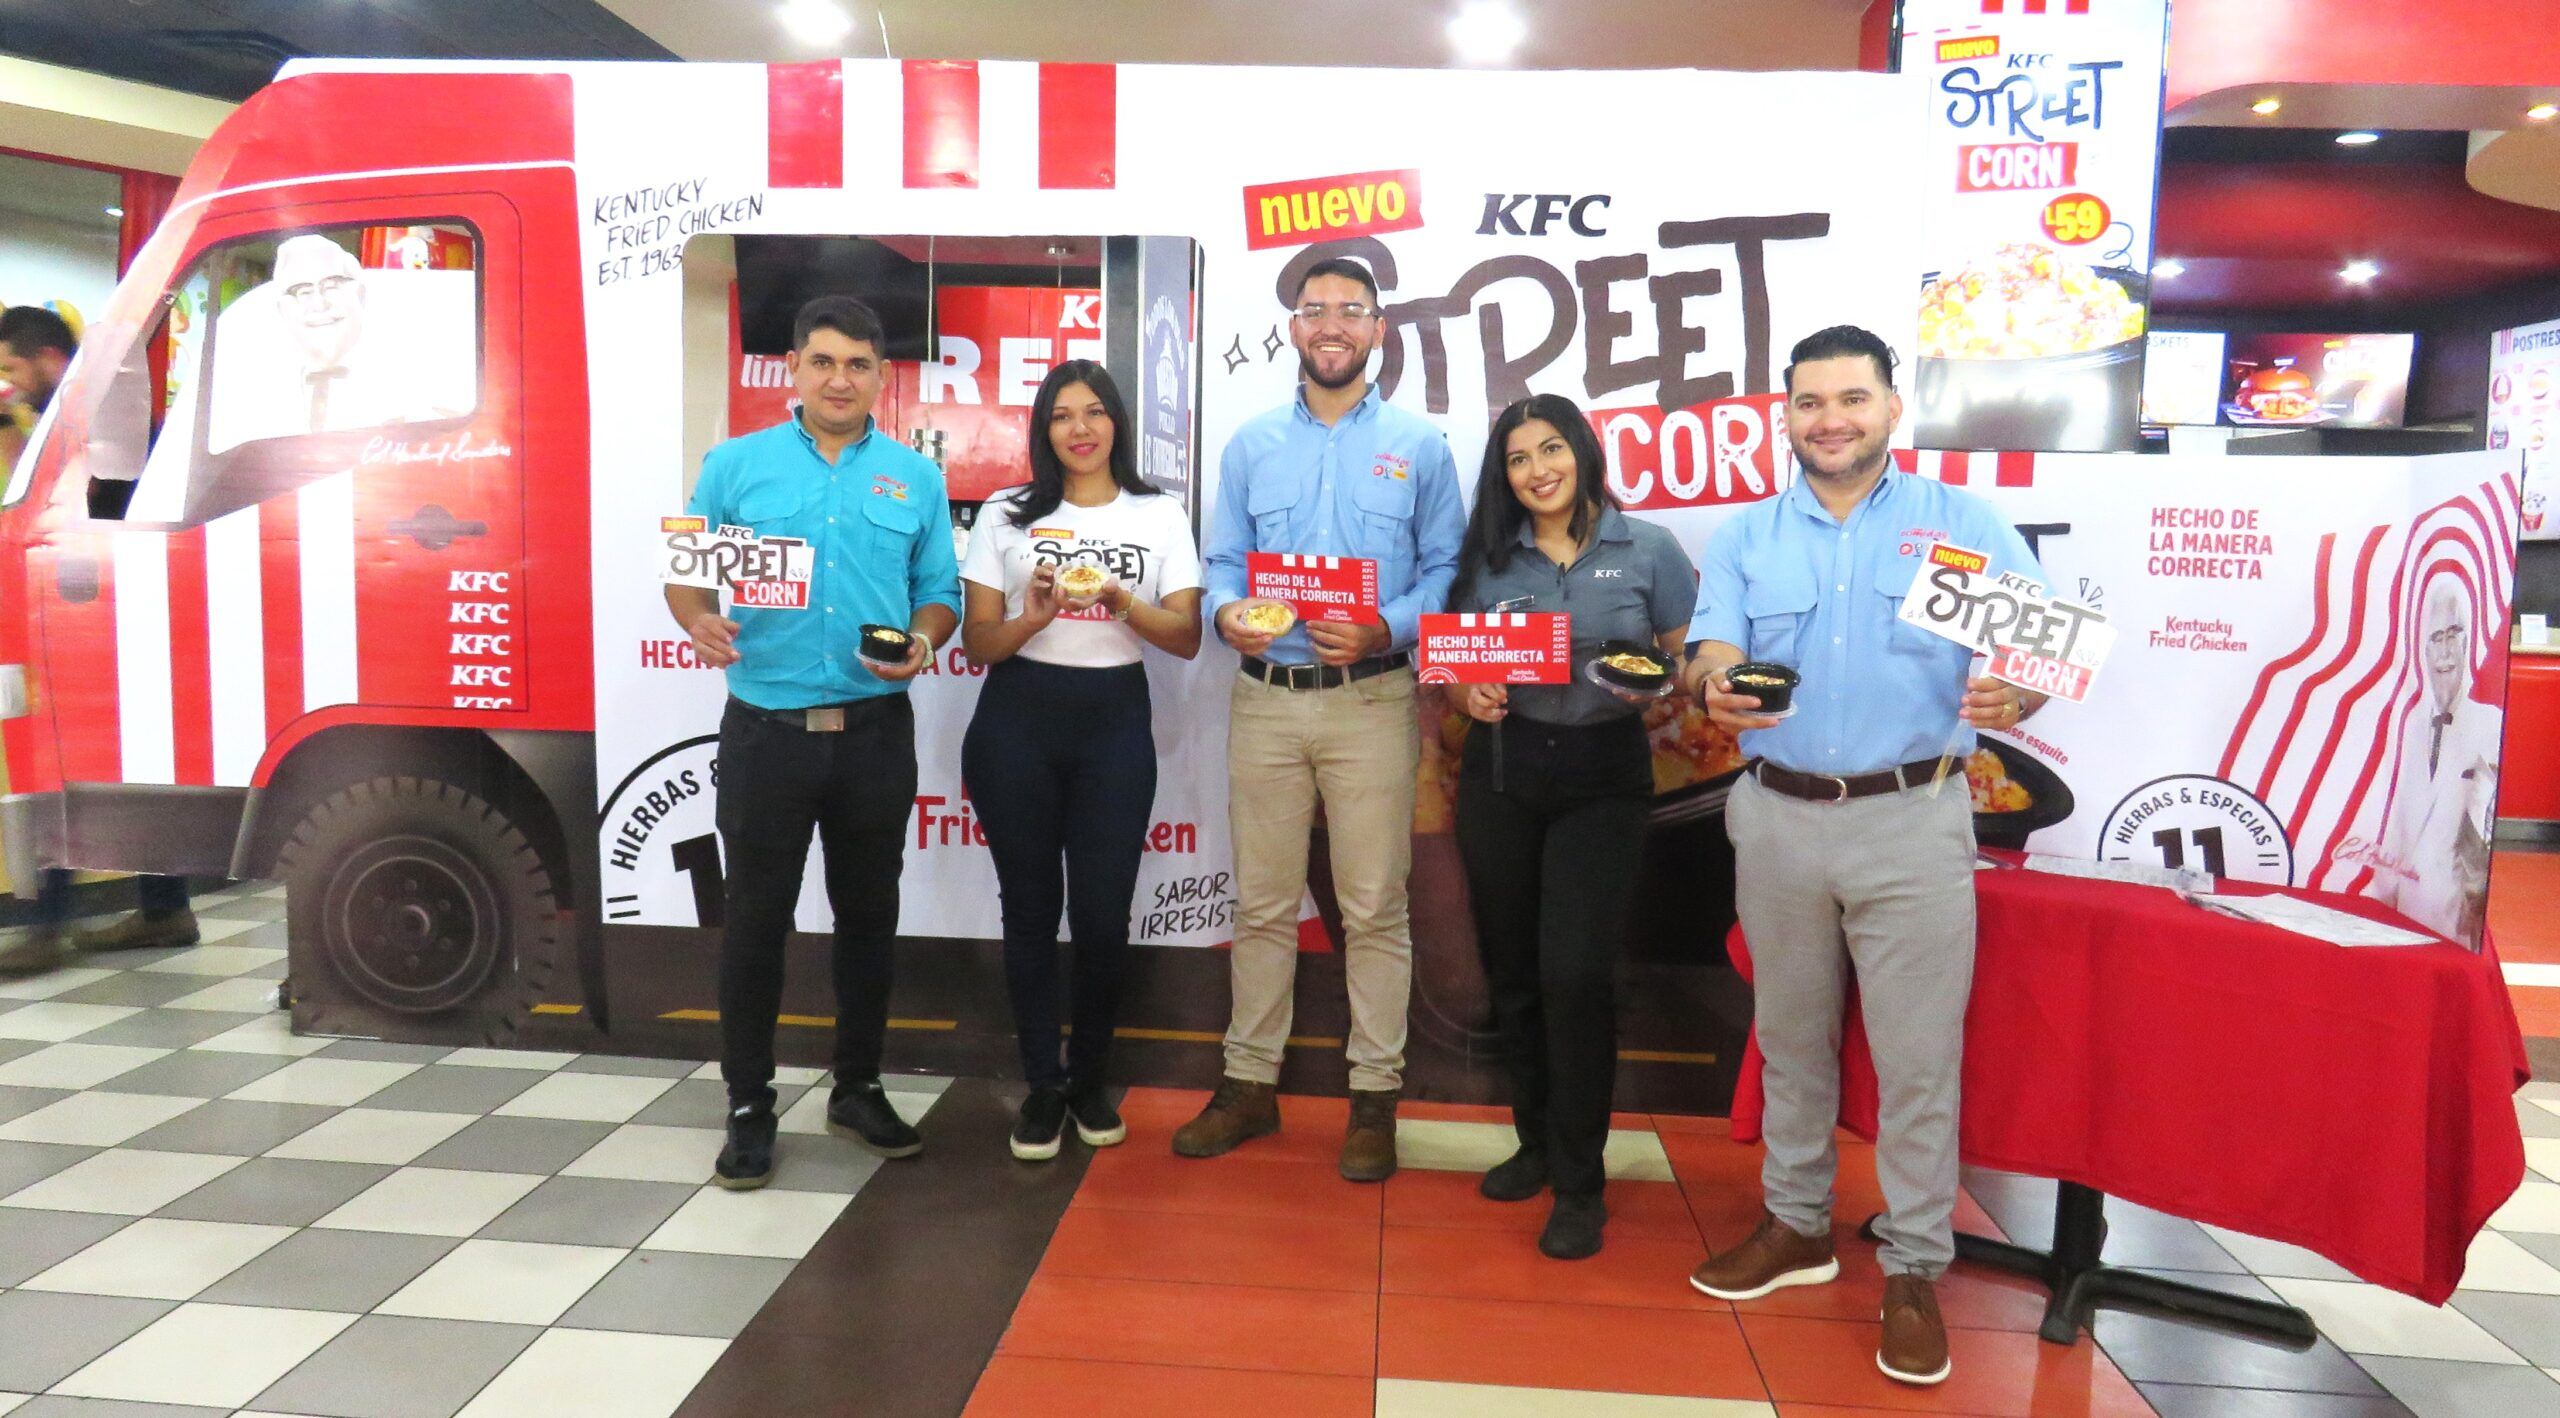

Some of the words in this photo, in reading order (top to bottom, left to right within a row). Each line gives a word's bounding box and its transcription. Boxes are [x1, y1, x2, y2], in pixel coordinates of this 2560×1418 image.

[1939, 39, 1996, 61] nuevo
[2007, 53, 2054, 68] KFC
[1940, 61, 2123, 142] STREET
[1968, 146, 2063, 188] CORN
[594, 177, 708, 226] KENTUCKY
[1259, 181, 1406, 236] nuevo
[679, 193, 764, 235] CHICKEN
[1476, 193, 1612, 238] KFC
[641, 244, 683, 277] 1963
[1276, 213, 1831, 428] STREET
[2151, 507, 2224, 529] HECHO
[2231, 509, 2259, 530] DE
[718, 526, 752, 540] KFC
[1034, 529, 1072, 539] nuevo
[2149, 532, 2174, 551] LA
[2181, 533, 2273, 555] MANERA
[667, 532, 804, 592] STREET
[1934, 547, 1982, 571] nuevo
[2147, 556, 2262, 580] CORRECTA
[447, 571, 509, 593] KFC
[1255, 572, 1290, 587] HECHO
[1292, 575, 1306, 588] DE
[1308, 576, 1321, 588] LA
[1593, 569, 1622, 578] KFC
[1998, 573, 2043, 598] KFC
[744, 582, 798, 605] CORN
[1256, 587, 1299, 600] MANERA
[1300, 590, 1356, 604] CORRECTA
[449, 602, 510, 624] KFC
[1926, 567, 2107, 662] STREET
[2166, 615, 2233, 637] Kentucky
[449, 633, 511, 656] KFC
[1428, 636, 1468, 649] HECHO
[1471, 636, 1487, 648] DE
[1489, 636, 1505, 648] LA
[2149, 630, 2187, 648] Fried
[2190, 633, 2248, 652] Chicken
[641, 640, 713, 670] HEC
[1428, 650, 1477, 663] MANERA
[1480, 650, 1545, 663] CORRECTA
[450, 665, 512, 687] KFC
[2004, 650, 2081, 697] CORN
[2026, 734, 2069, 766] esquite
[610, 769, 701, 872] HIERBAS
[2115, 792, 2174, 844] HIERBAS
[2180, 787, 2193, 804] &
[2199, 790, 2272, 846] ESPECIAS
[2152, 826, 2226, 878] 11
[1154, 872, 1229, 909] SABOR
